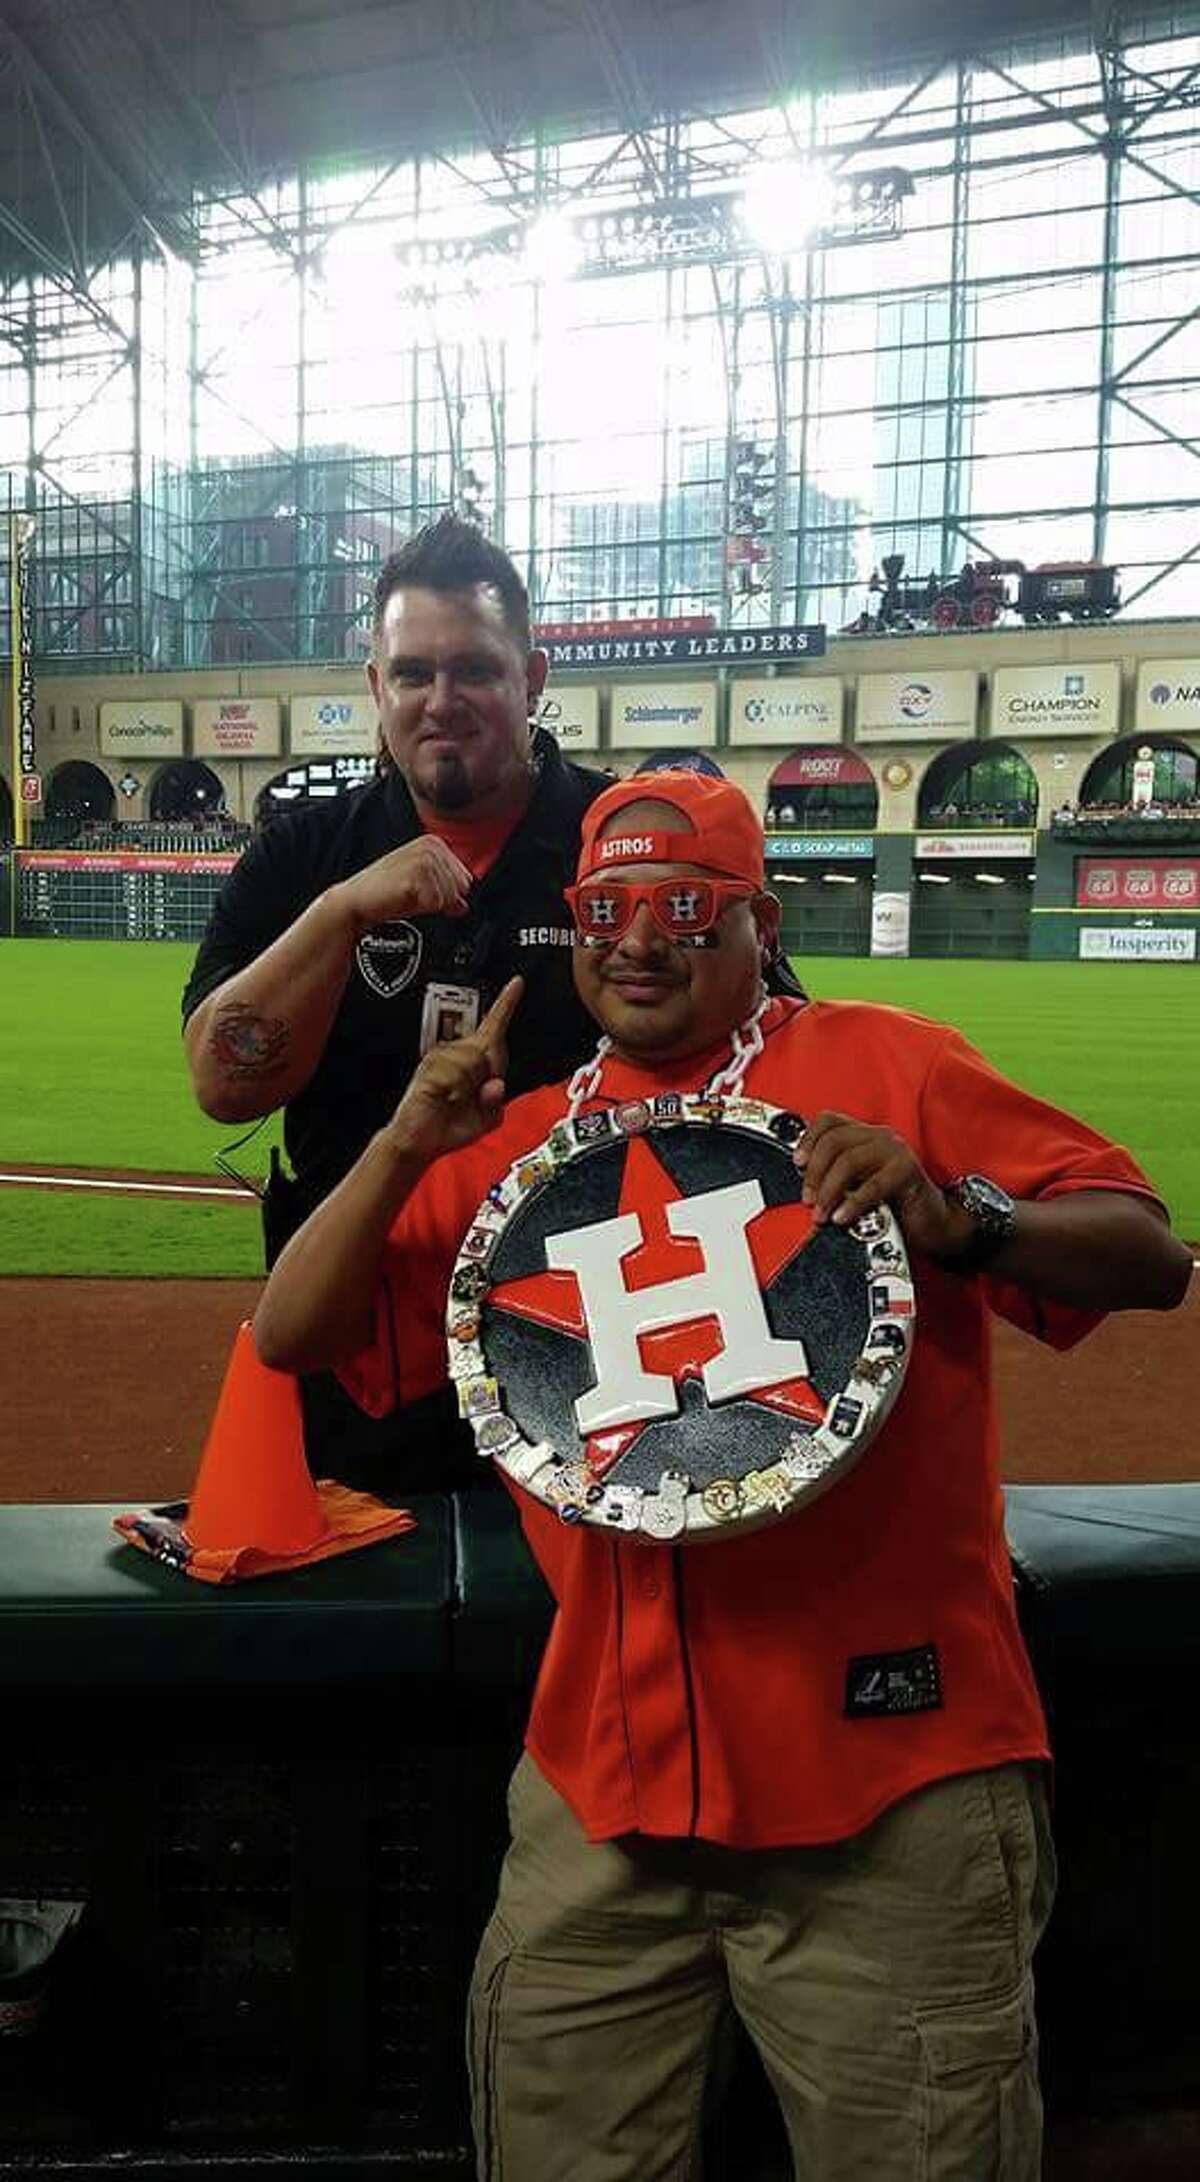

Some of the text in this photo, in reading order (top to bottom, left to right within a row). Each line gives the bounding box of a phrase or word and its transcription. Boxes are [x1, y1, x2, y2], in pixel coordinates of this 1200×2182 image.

[536, 633, 809, 661] MMUNITY LEADERS
[623, 705, 703, 724] Schlumberger
[767, 703, 828, 717] CALPINE
[1008, 698, 1100, 712] CHAMPION
[108, 721, 175, 738] ConocoPhillips
[669, 894, 698, 921] H
[518, 927, 576, 947] SECURI
[1109, 935, 1187, 955] Insperity
[656, 1102, 677, 1117] 50
[543, 1178, 811, 1432] H
